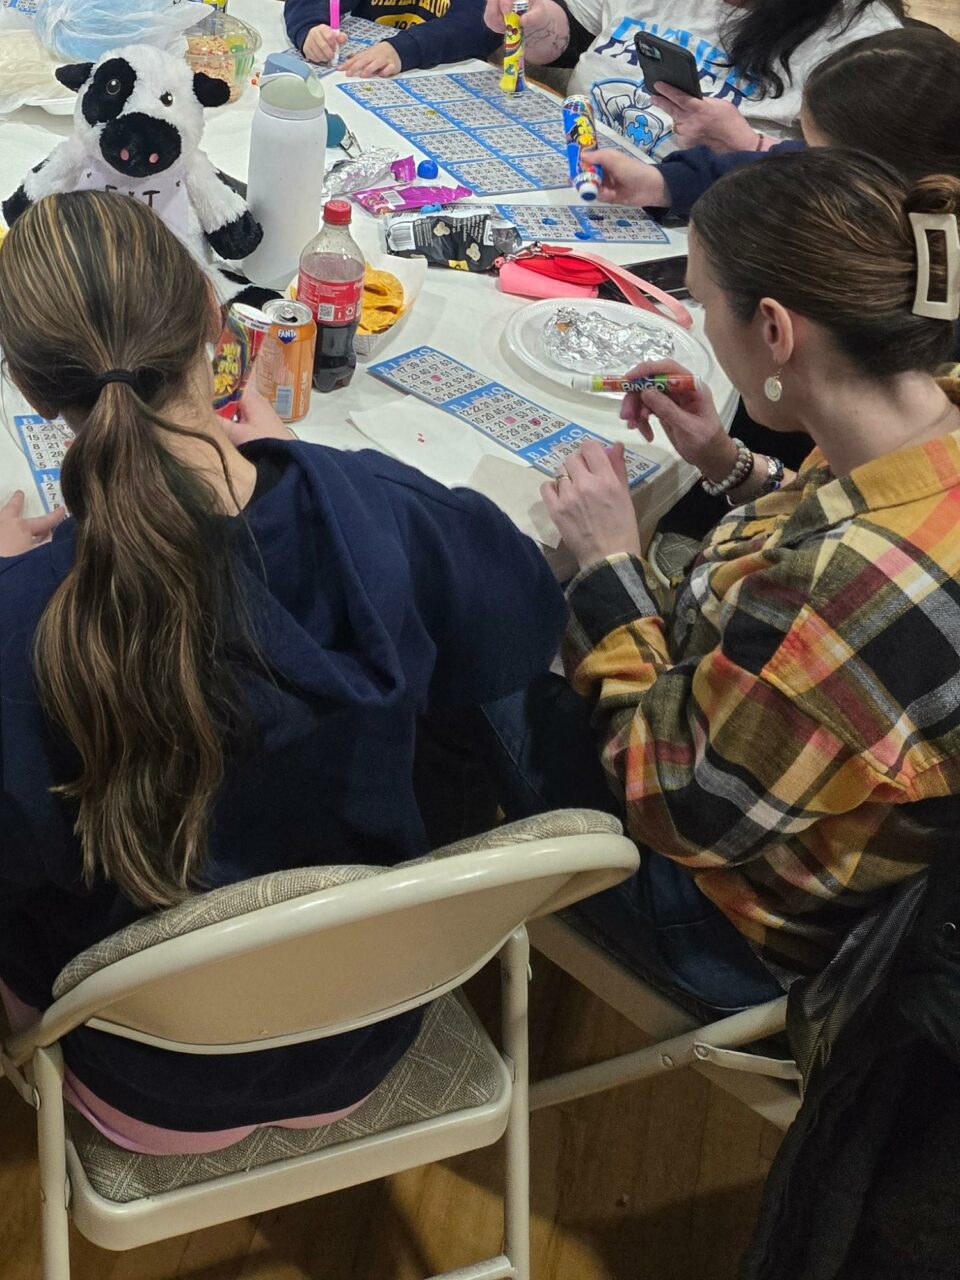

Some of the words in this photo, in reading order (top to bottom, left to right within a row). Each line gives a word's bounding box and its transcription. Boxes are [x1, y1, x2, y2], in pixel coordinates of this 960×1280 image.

[451, 366, 464, 374] 70
[621, 381, 666, 392] BINGO
[503, 403, 516, 411] 52
[485, 425, 495, 433] 2
[515, 411, 529, 419] 53
[539, 414, 551, 422] 61
[549, 452, 561, 461] 17
[561, 447, 573, 456] 33
